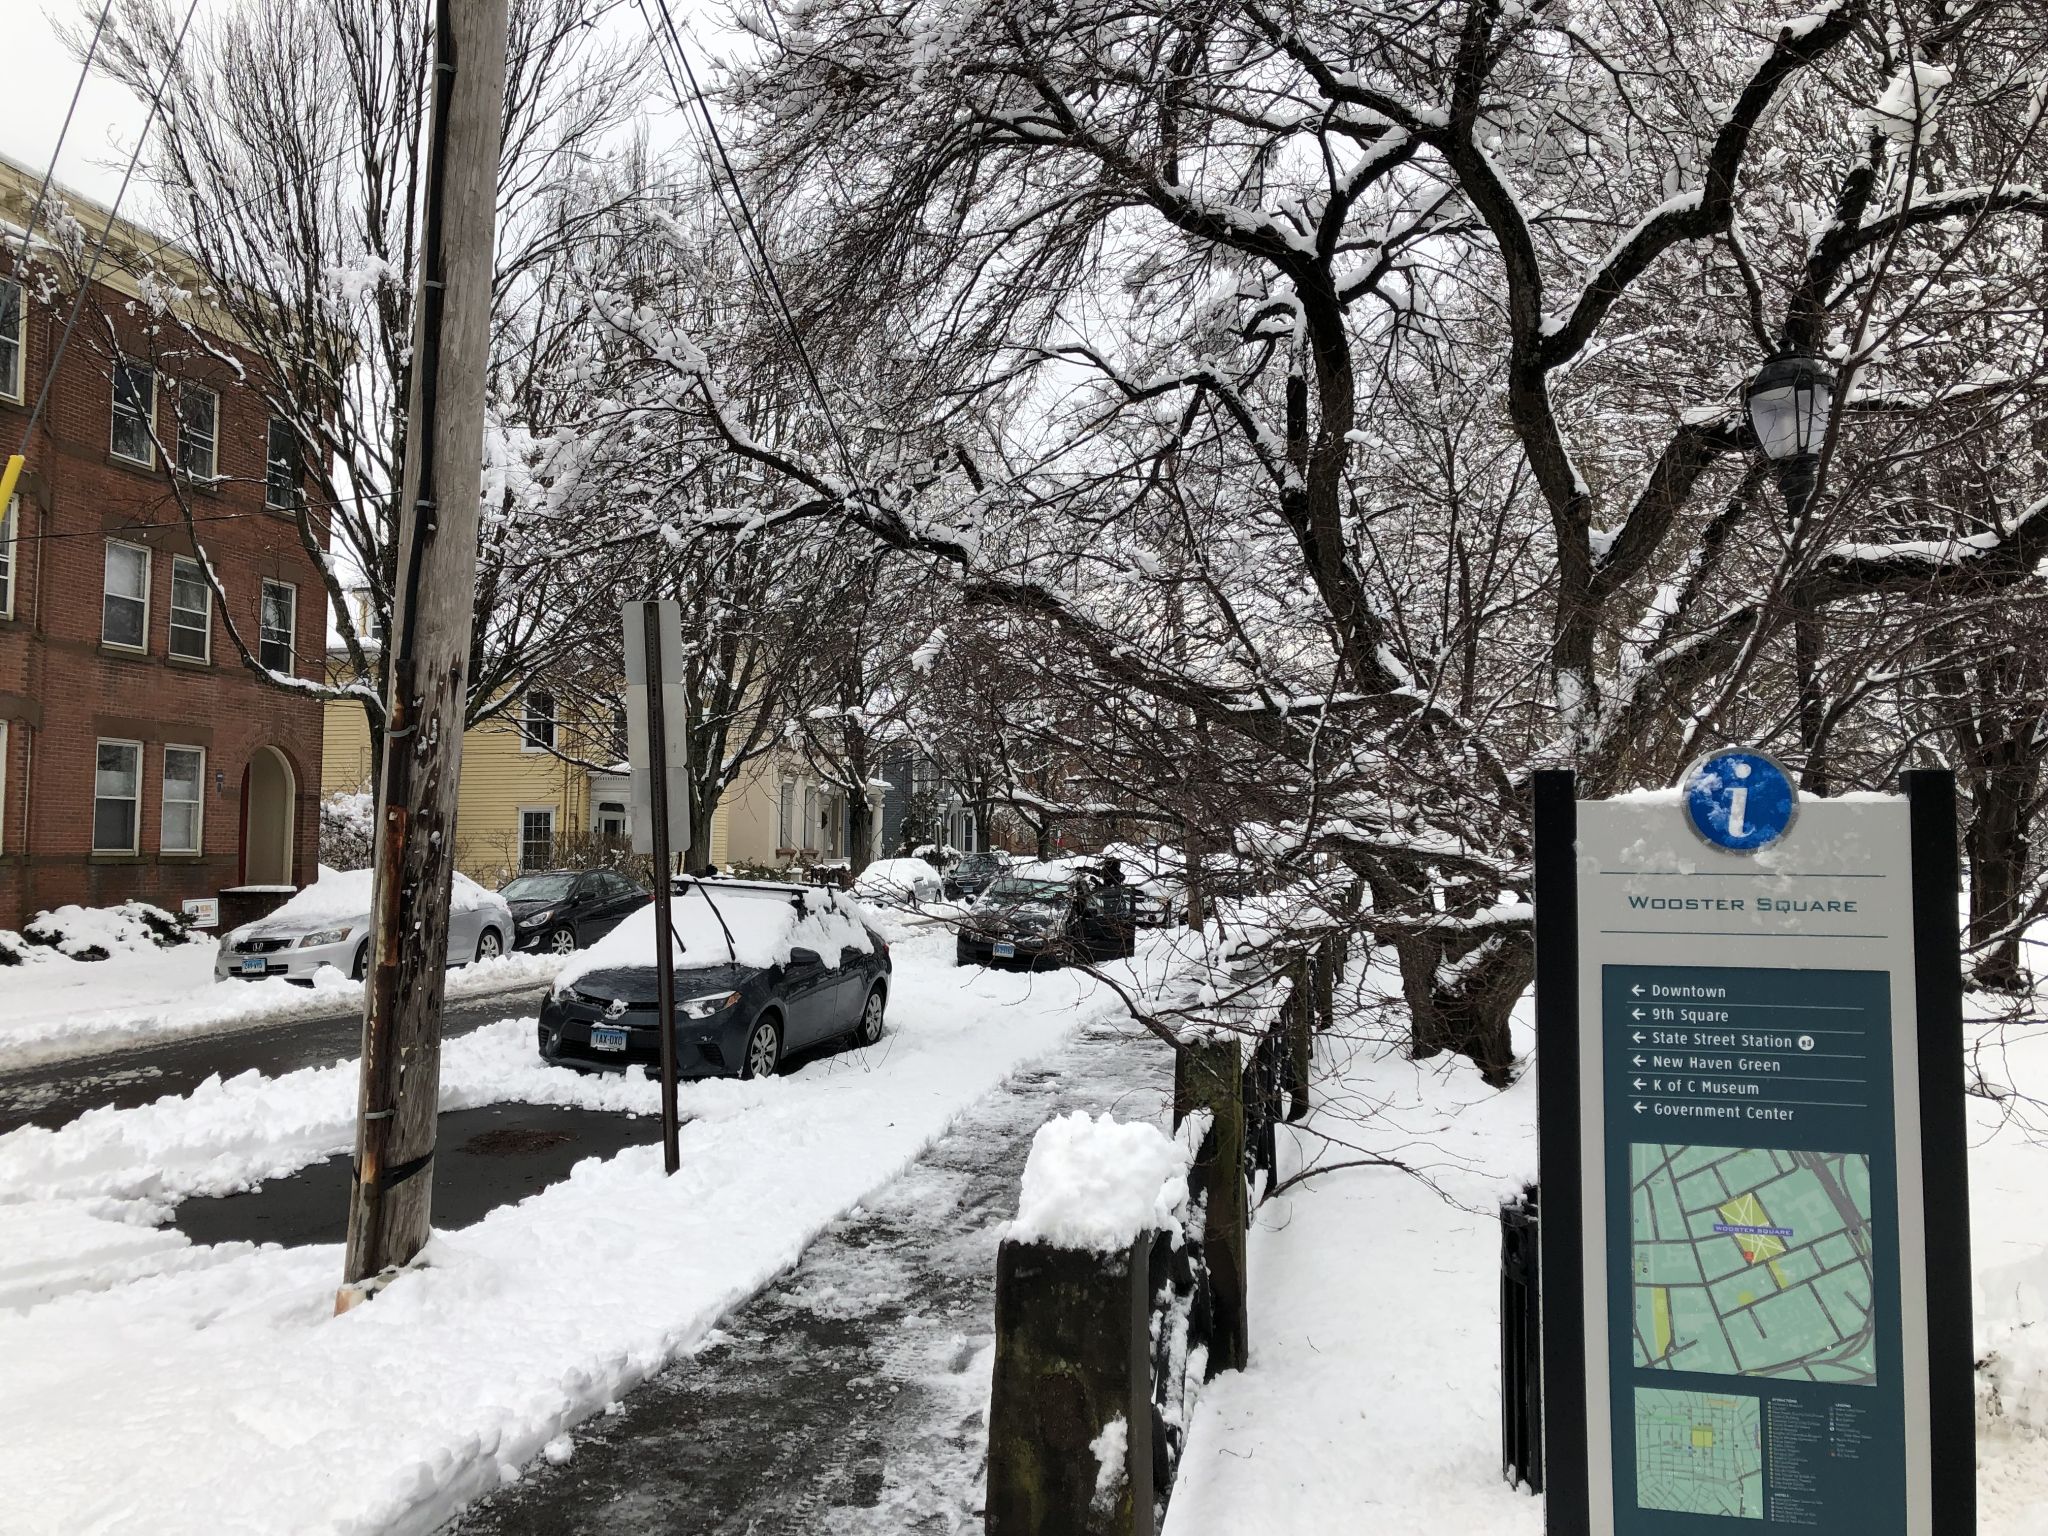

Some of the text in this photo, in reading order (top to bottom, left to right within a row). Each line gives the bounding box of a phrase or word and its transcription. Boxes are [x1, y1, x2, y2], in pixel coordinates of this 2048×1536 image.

[1627, 895, 1858, 915] WOOSTER SQUARE
[1652, 984, 1726, 998] Downtown
[1652, 1007, 1729, 1024] 9th Square
[1652, 1031, 1792, 1048] State Street Station
[1653, 1055, 1781, 1072] New Haven Green
[1654, 1079, 1759, 1095] K of C Museum
[1654, 1102, 1794, 1121] Government Center
[1757, 1228, 1791, 1236] SQUARE
